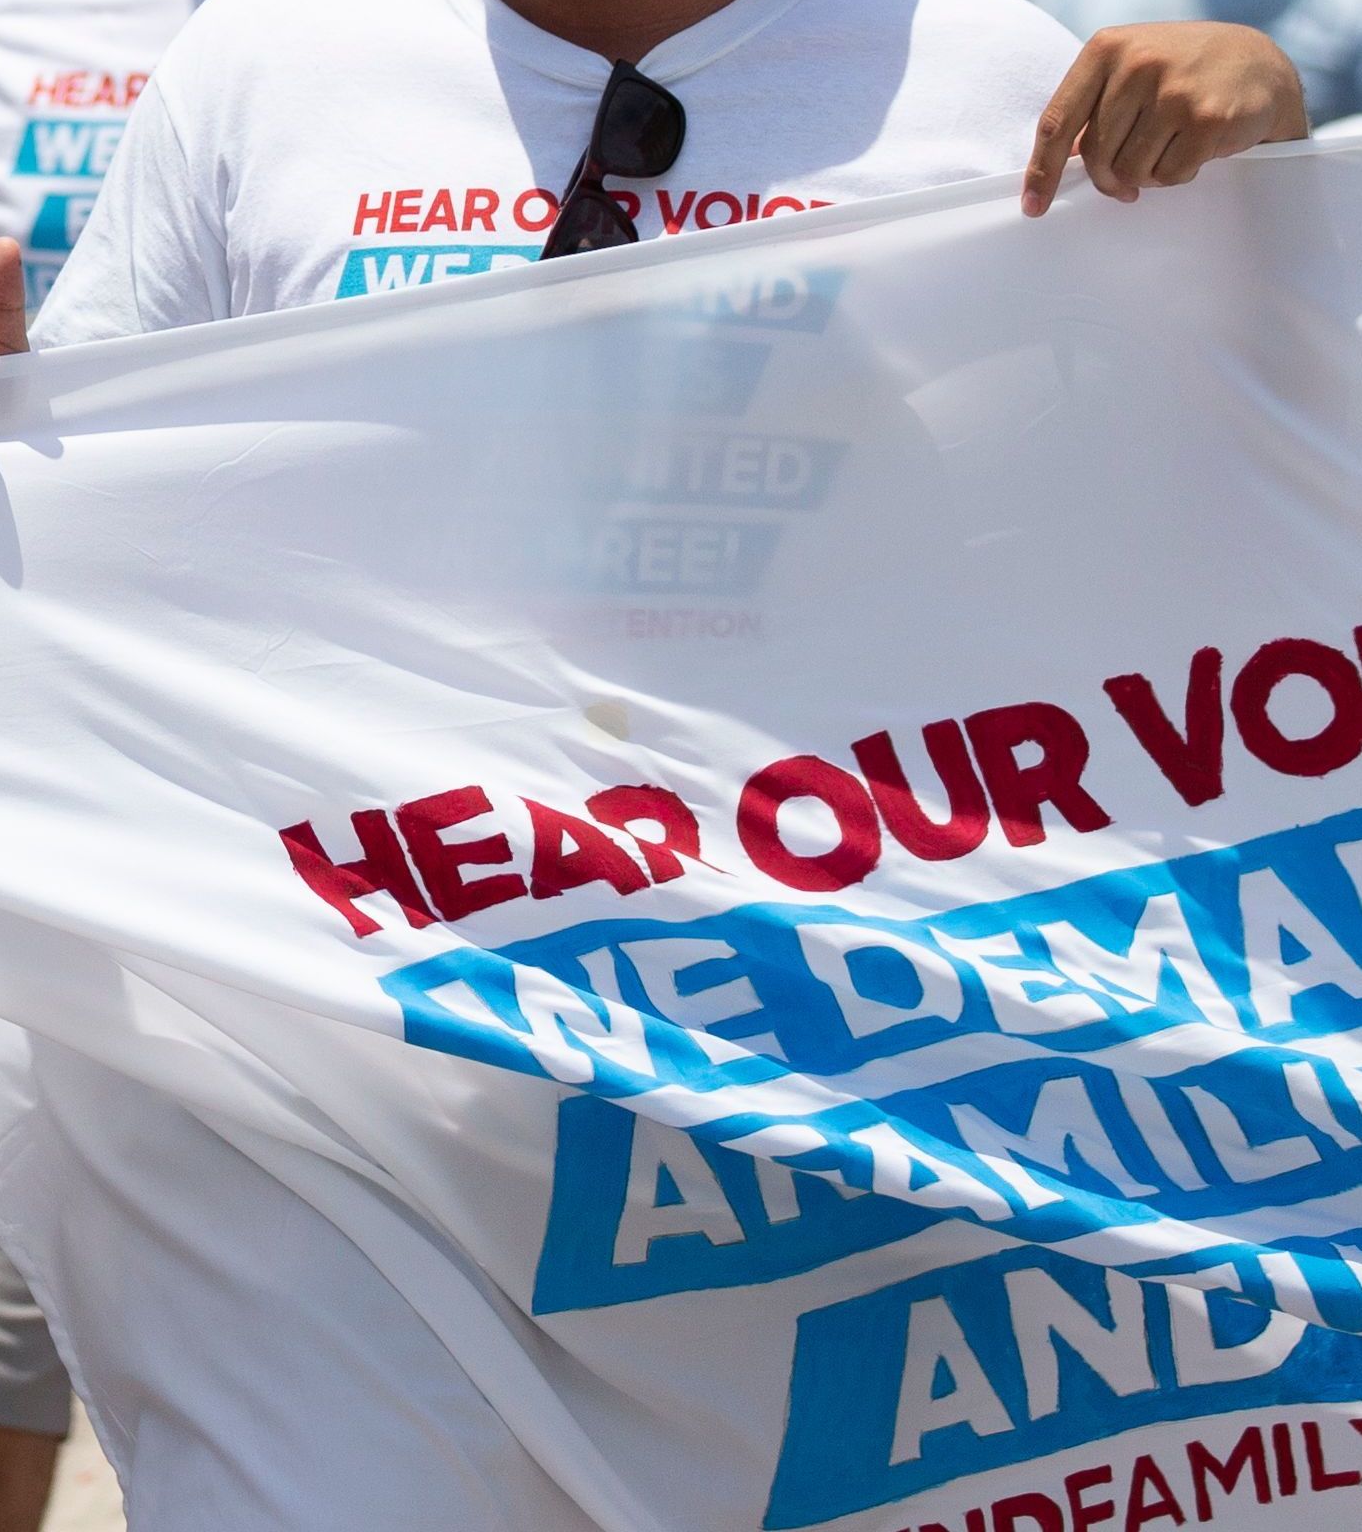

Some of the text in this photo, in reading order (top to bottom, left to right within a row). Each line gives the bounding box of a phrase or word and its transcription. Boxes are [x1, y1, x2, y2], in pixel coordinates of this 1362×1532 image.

[353, 188, 500, 235] HEAR
[277, 783, 736, 940] HEAR
[735, 701, 1115, 892] OUR
